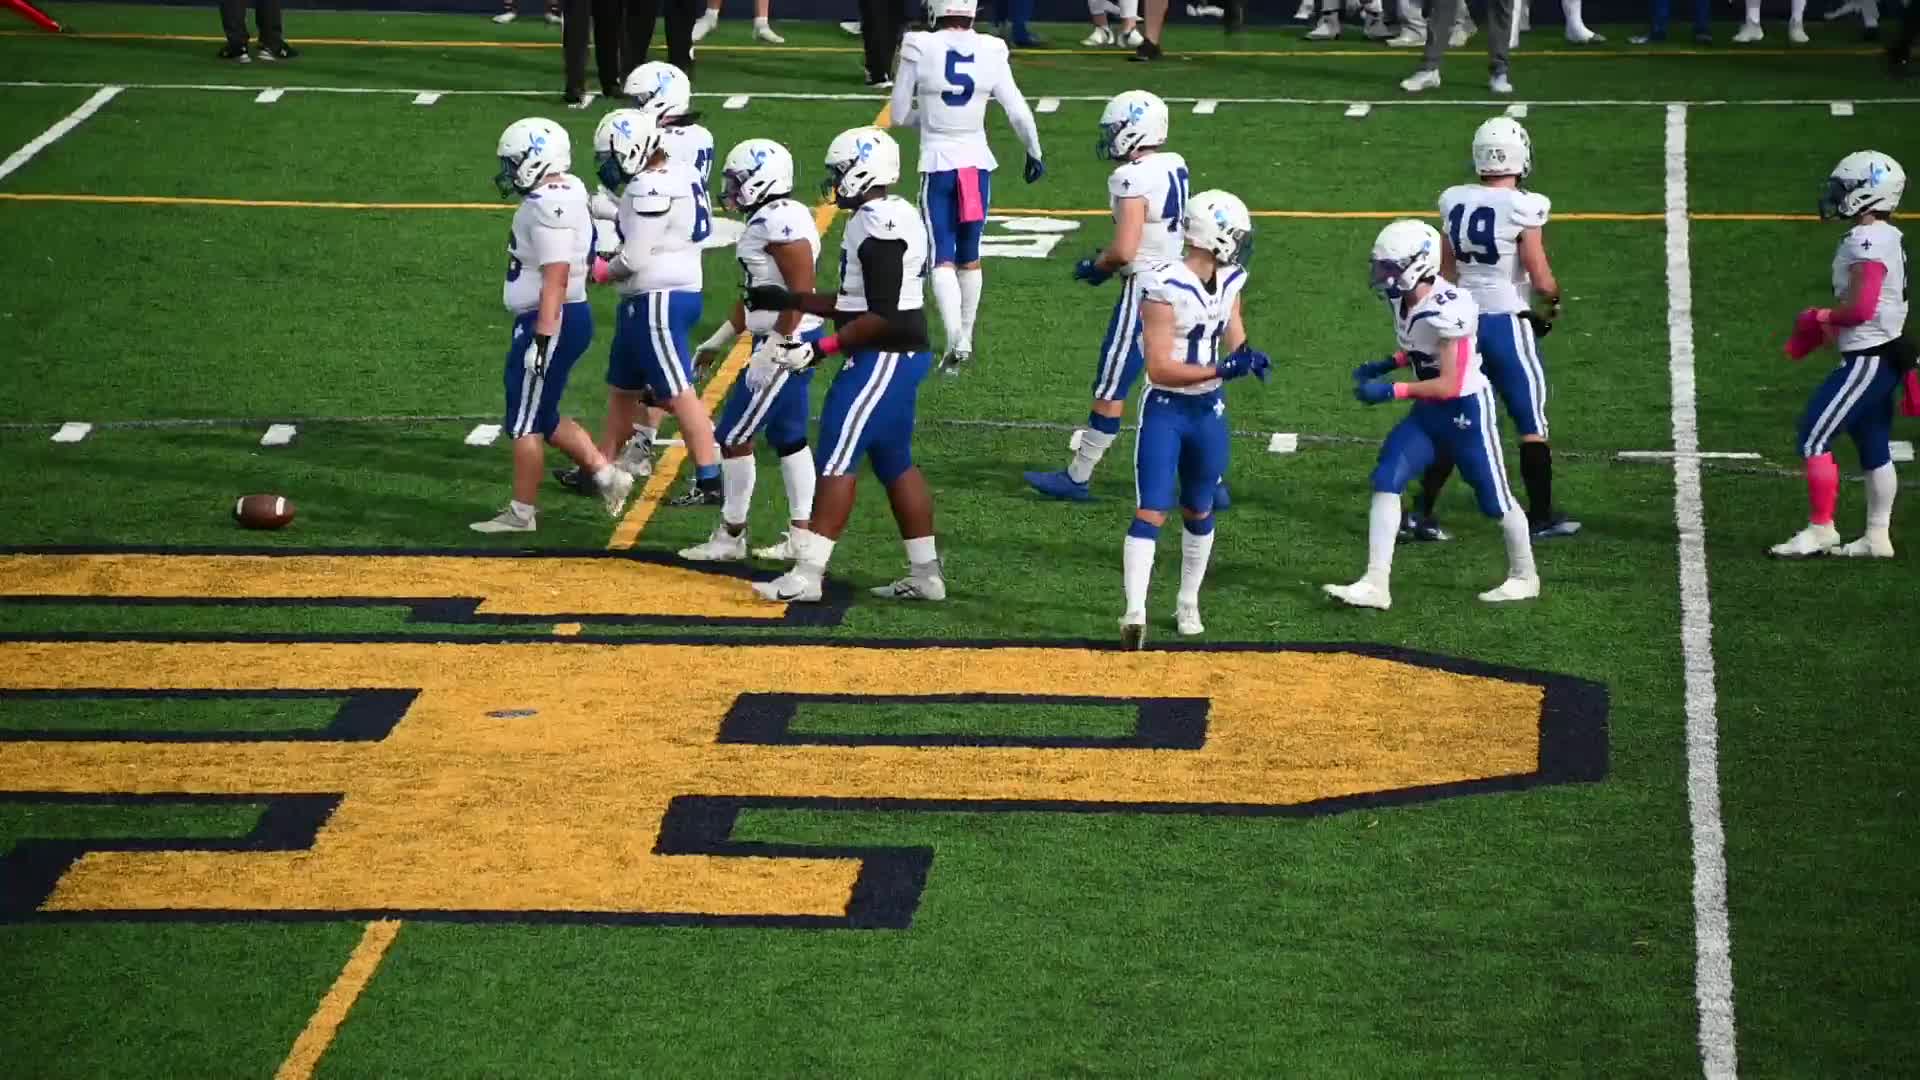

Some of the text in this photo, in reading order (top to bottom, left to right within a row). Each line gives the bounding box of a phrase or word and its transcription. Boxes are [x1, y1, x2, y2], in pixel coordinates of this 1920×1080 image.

[940, 49, 976, 108] 5
[1447, 202, 1501, 266] 19
[1434, 288, 1459, 305] 26
